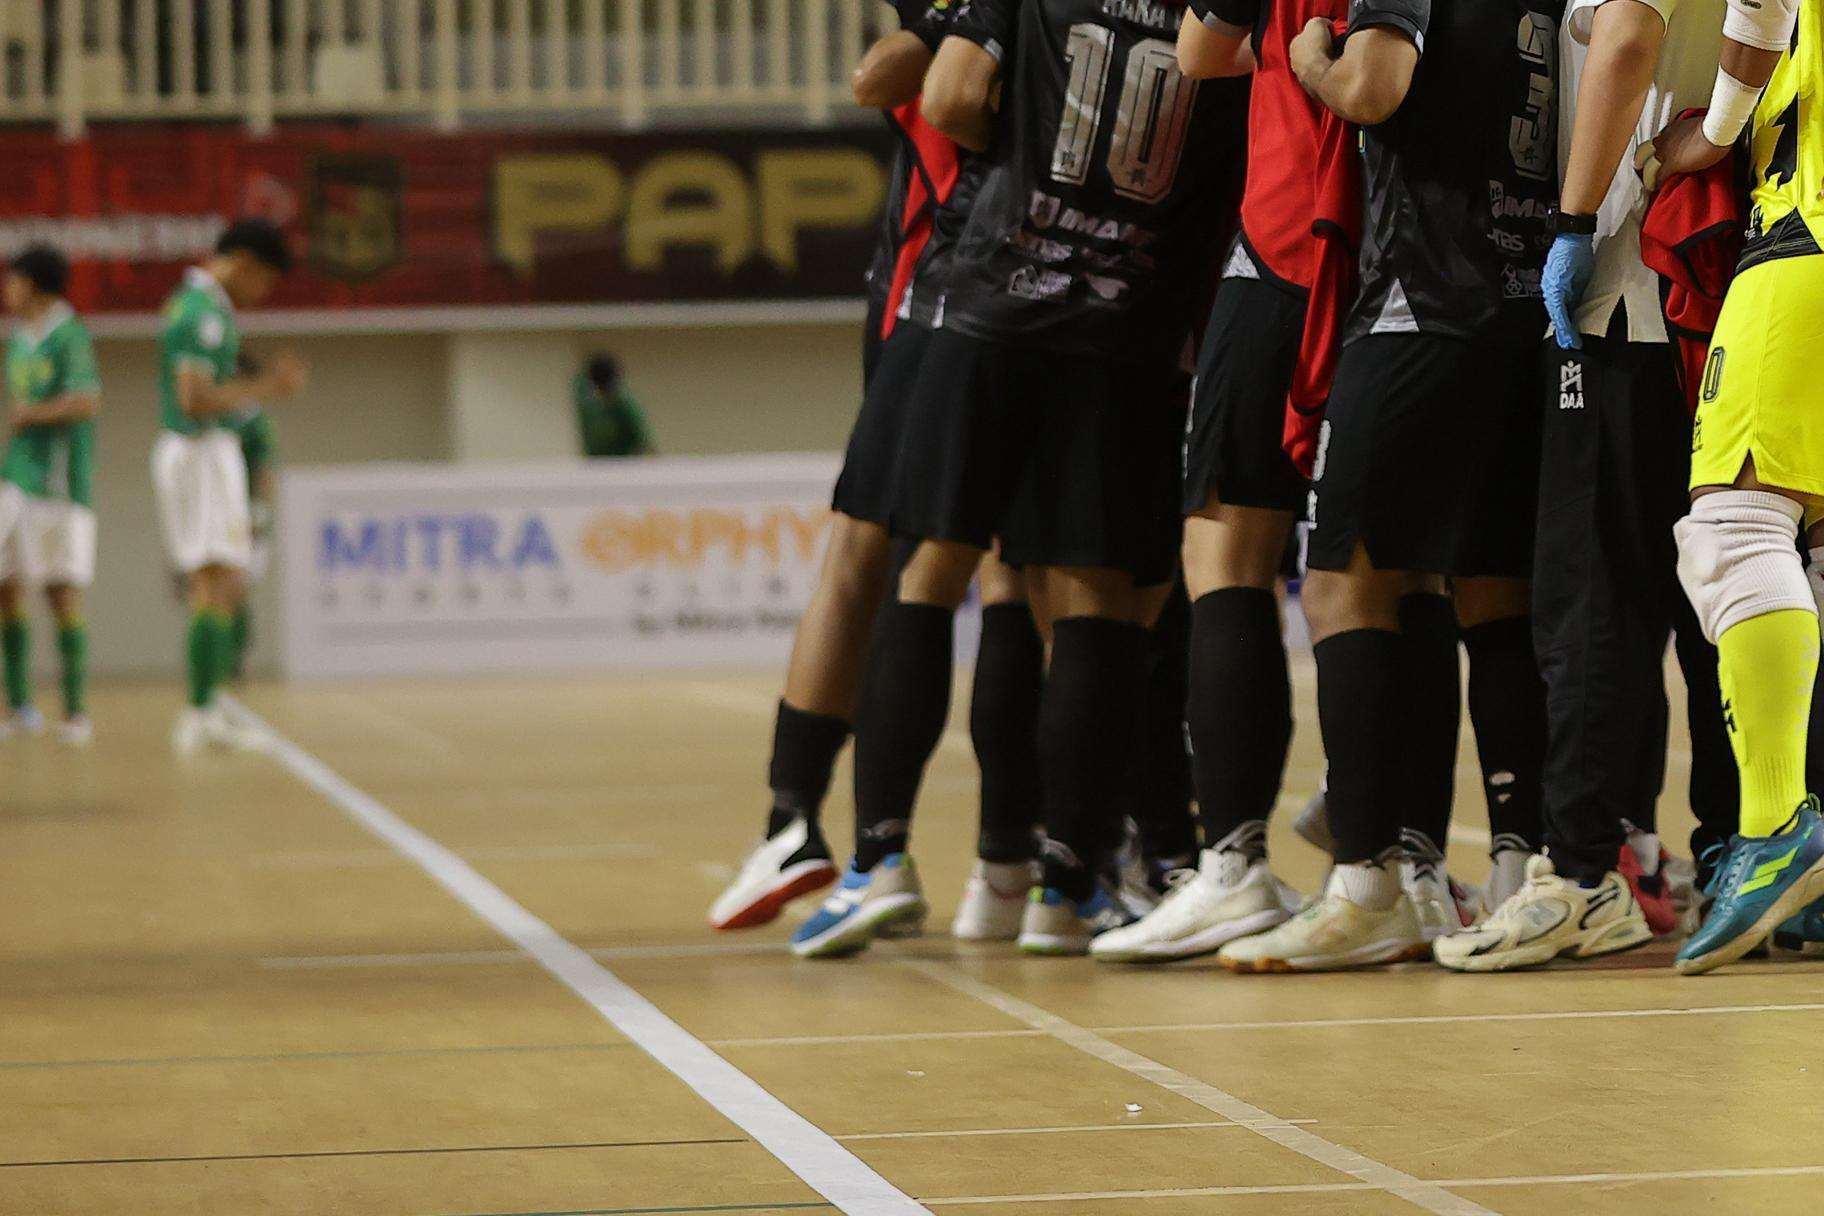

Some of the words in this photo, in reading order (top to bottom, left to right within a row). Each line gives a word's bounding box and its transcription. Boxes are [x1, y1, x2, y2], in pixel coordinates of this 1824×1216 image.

[1051, 22, 1201, 205] 10
[1559, 392, 1585, 410] DAA
[316, 512, 564, 574] MITRA
